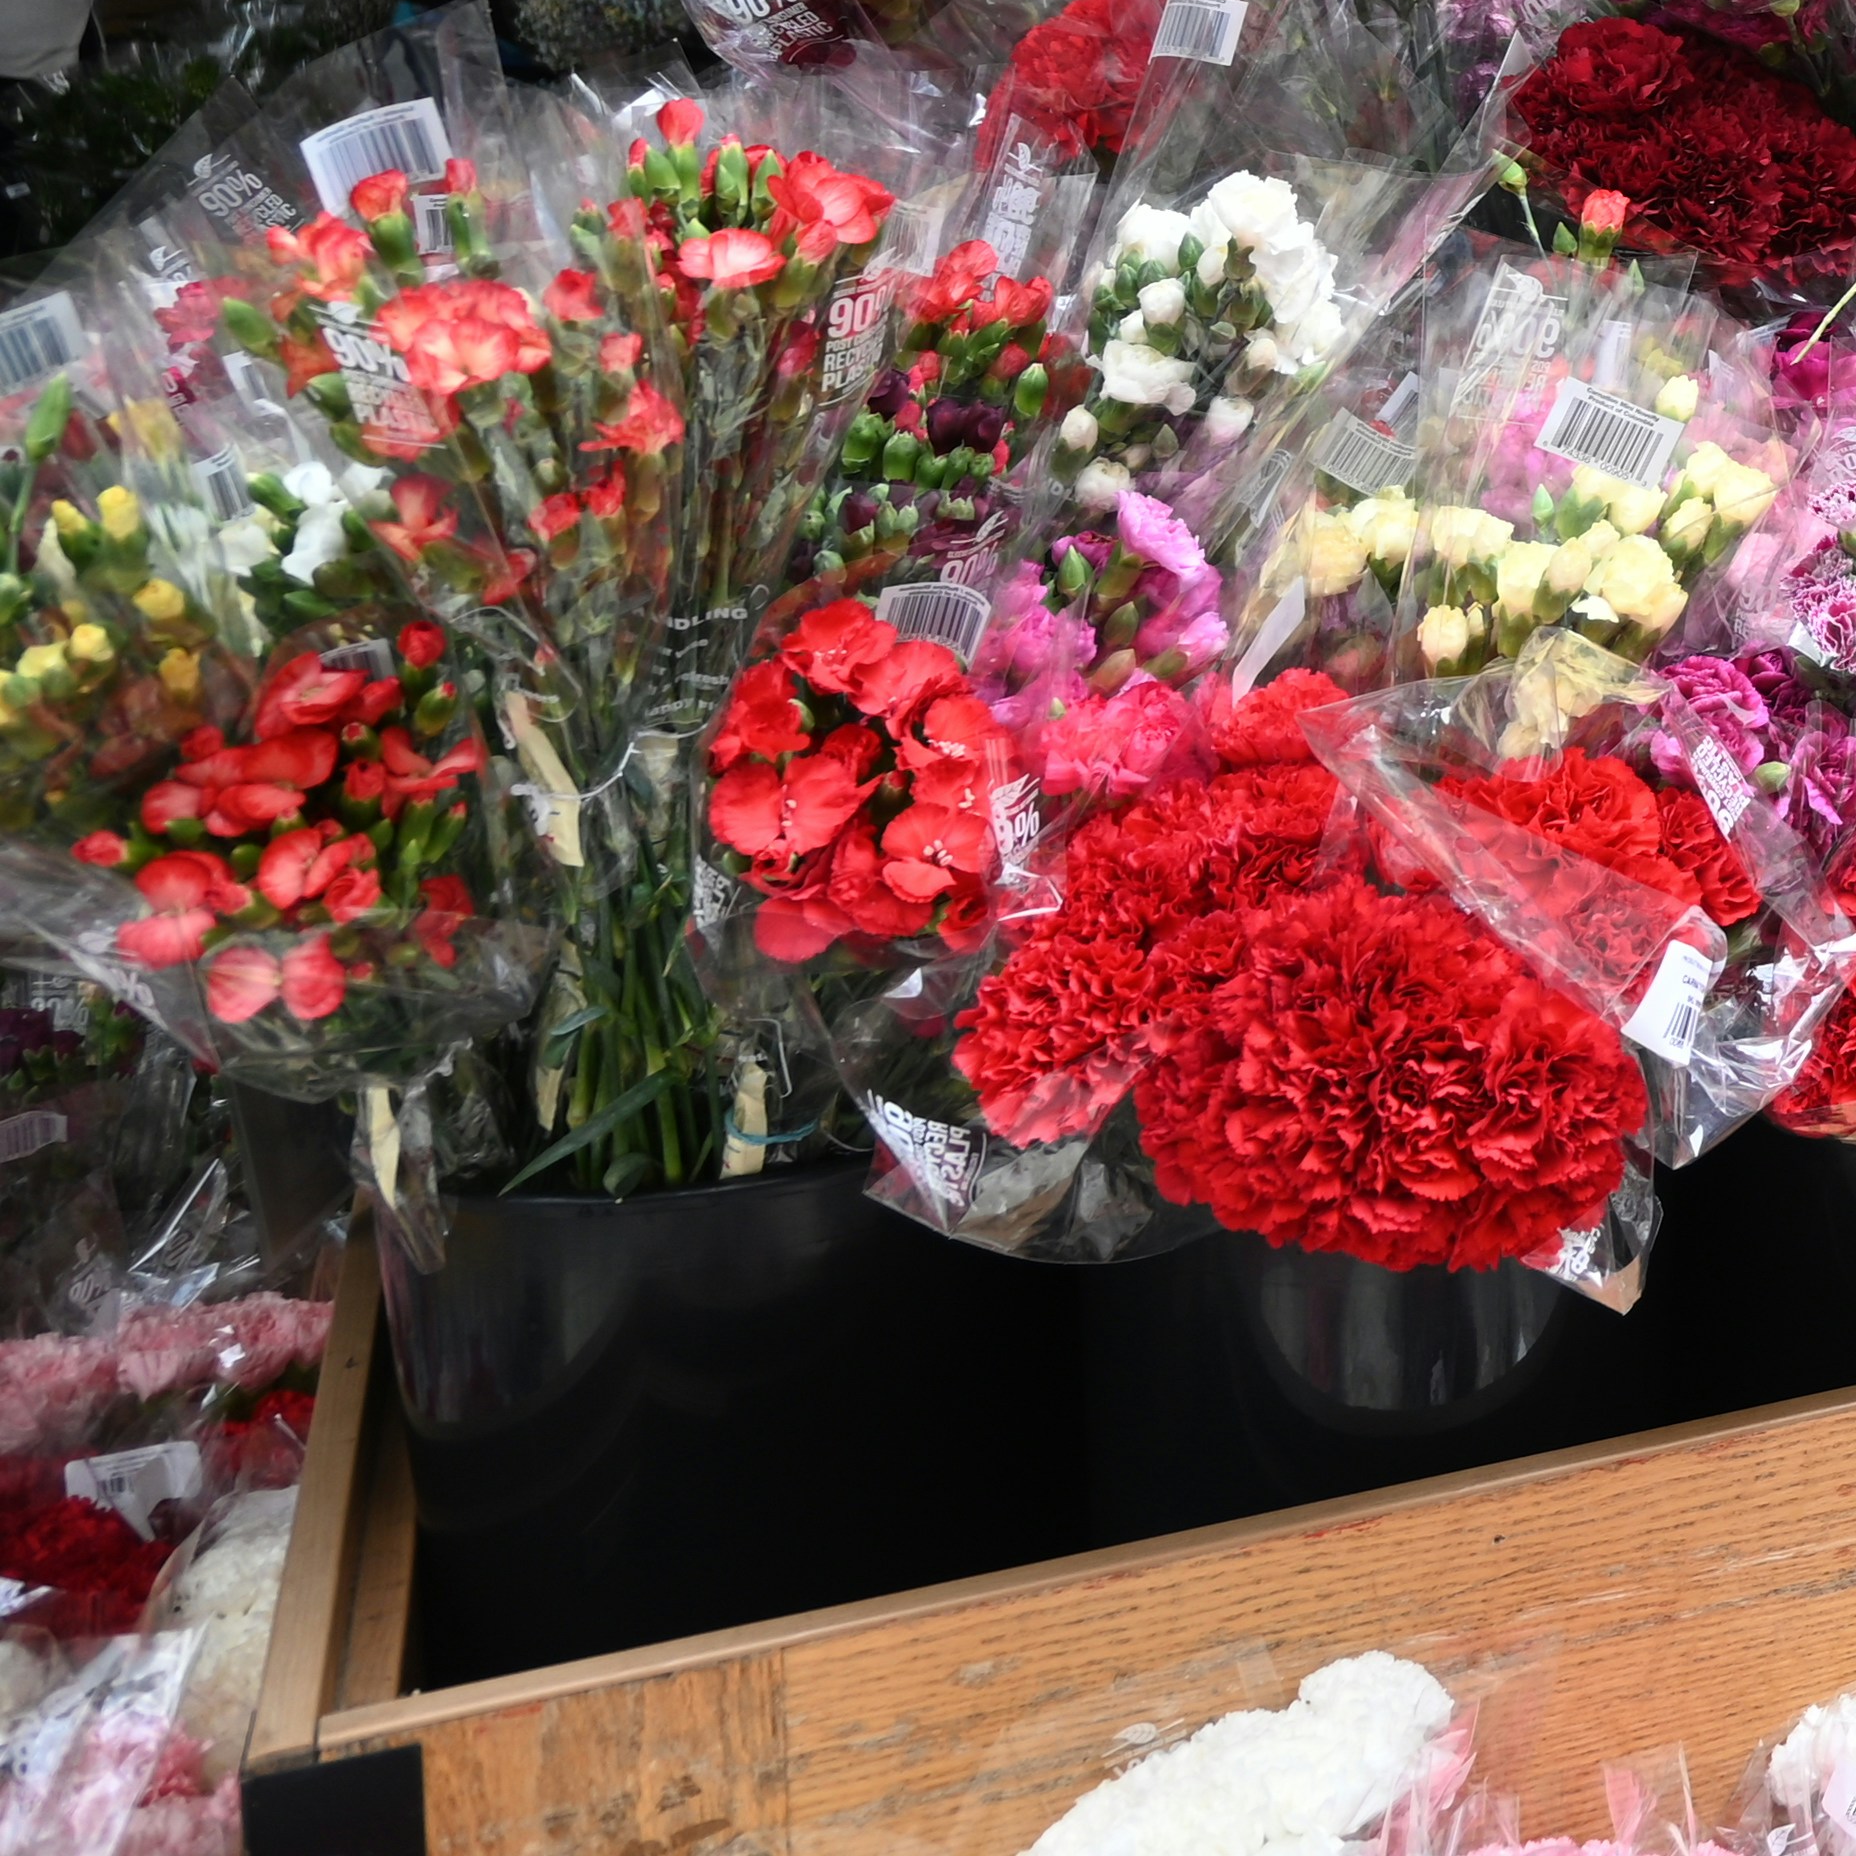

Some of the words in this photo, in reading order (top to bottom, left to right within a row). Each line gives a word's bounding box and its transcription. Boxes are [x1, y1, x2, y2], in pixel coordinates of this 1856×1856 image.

[198, 170, 262, 217] 90%
[828, 278, 895, 339] 90%
[322, 326, 411, 383] 90%
[825, 336, 853, 354] POST
[1586, 386, 1619, 406] Carnation
[1619, 400, 1635, 412] Mini
[1588, 394, 1615, 411] Product
[1615, 406, 1623, 415] of
[1599, 462, 1630, 481] 00905
[940, 542, 1000, 585] 90%
[1695, 742, 1745, 817] RECYCLED
[1703, 735, 1750, 809] PLASTIC
